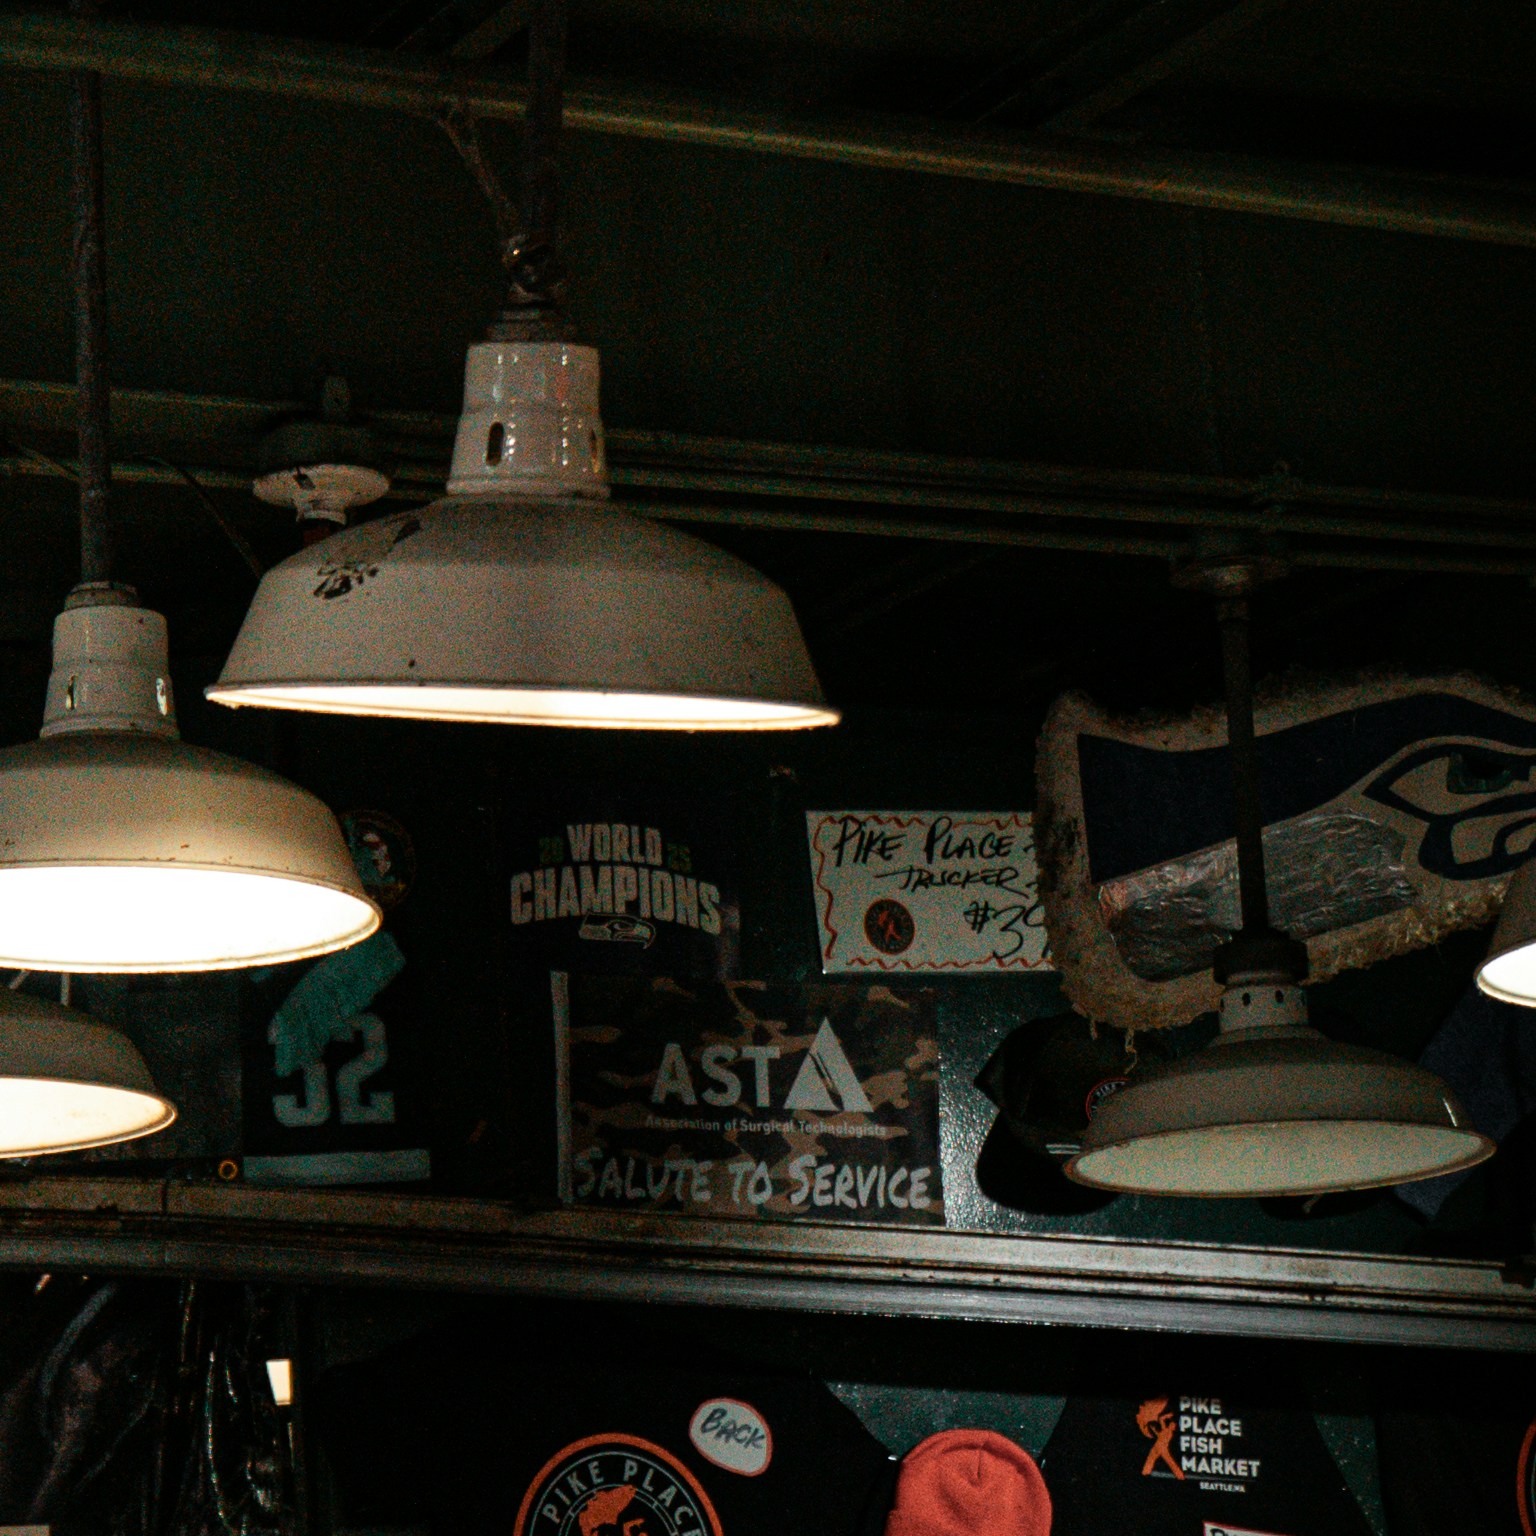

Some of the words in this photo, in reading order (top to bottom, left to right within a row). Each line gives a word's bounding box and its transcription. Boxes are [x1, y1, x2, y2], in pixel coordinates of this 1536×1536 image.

[566, 822, 663, 866] WORLD
[833, 815, 905, 867] PIKE
[926, 815, 1015, 865] PLACE
[510, 864, 722, 936] CHAMPIONS
[874, 864, 1030, 900] TRUCKER
[723, 1116, 739, 1133] of
[740, 1116, 796, 1136] Surgical
[799, 1120, 886, 1138] Technologists
[575, 1145, 713, 1203] SALUTE
[728, 1159, 774, 1206] TO
[790, 1153, 932, 1210] SERVICE
[1179, 1395, 1222, 1416] PIKE
[699, 1408, 768, 1450] BACK
[1179, 1416, 1242, 1437] PLACE
[1179, 1435, 1223, 1455] FISH
[1181, 1456, 1261, 1478] MARKET
[542, 1460, 606, 1525] PIKE
